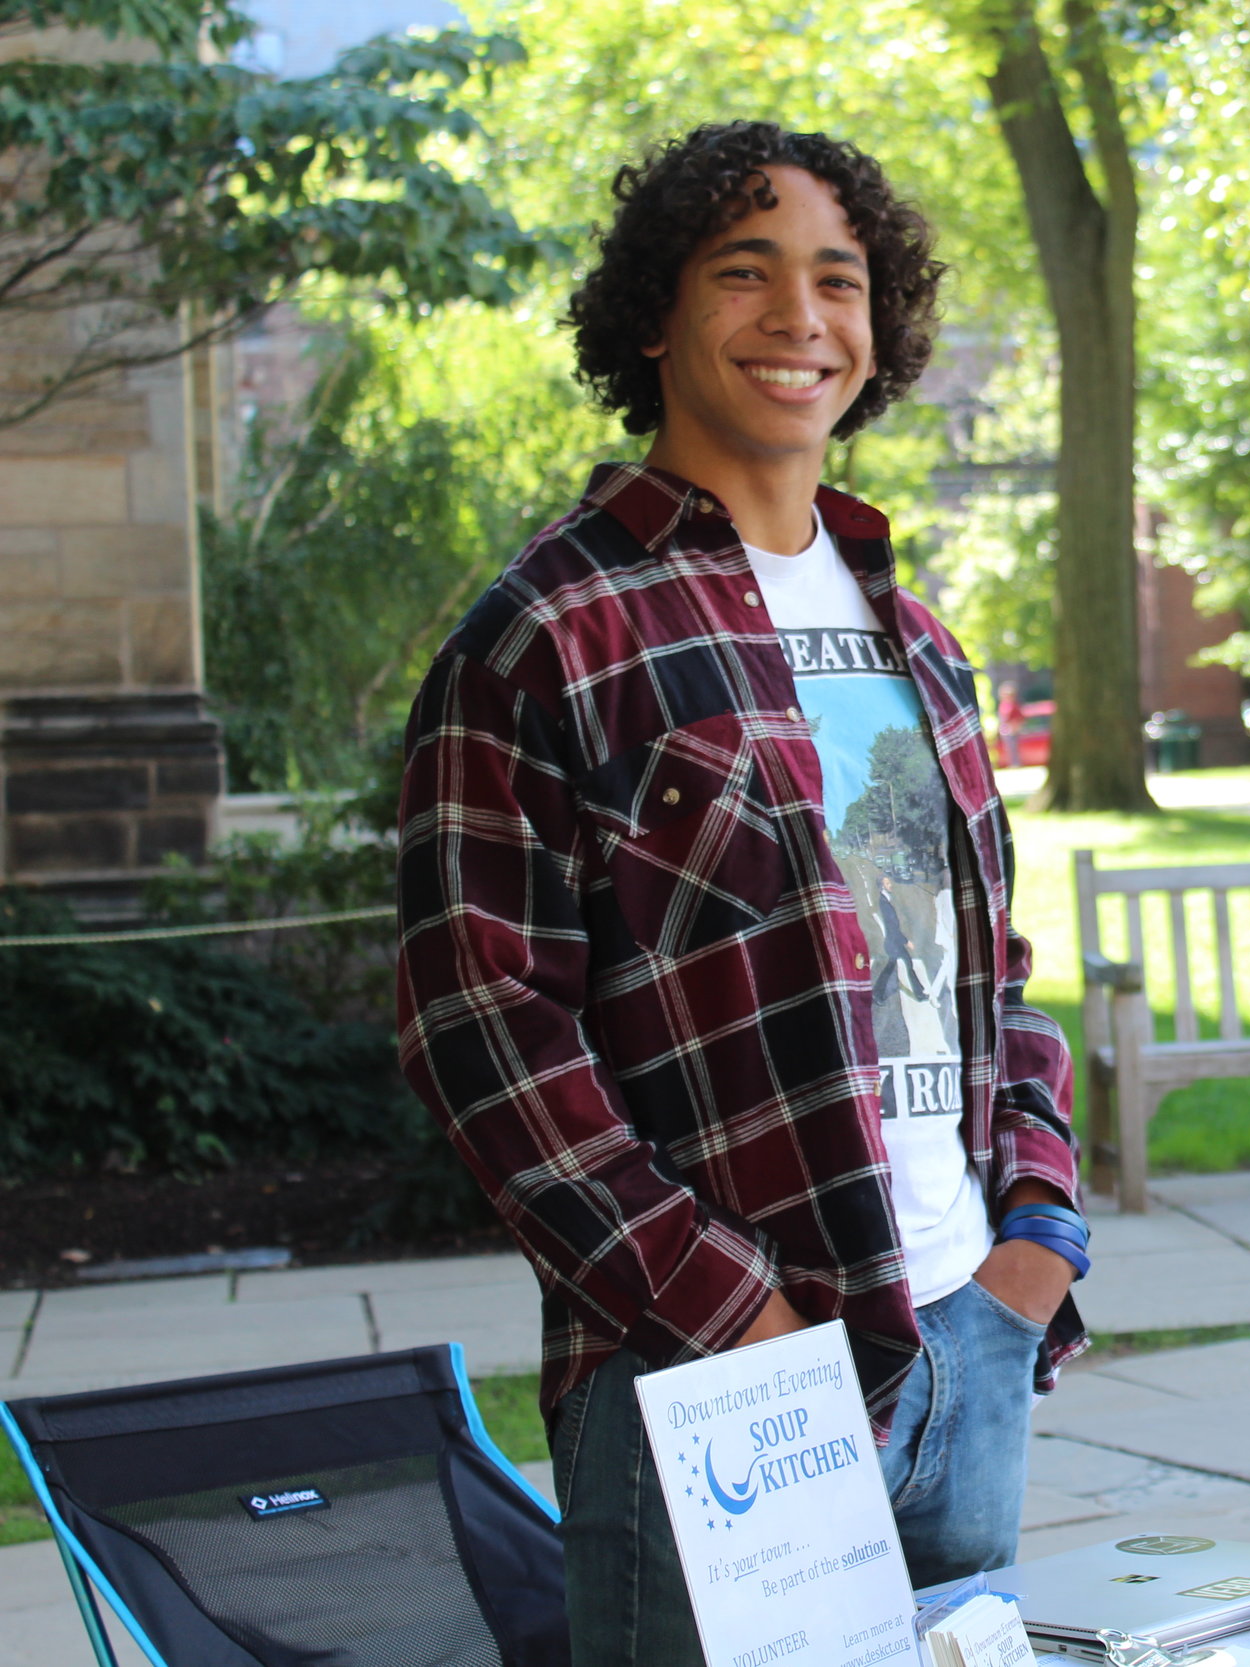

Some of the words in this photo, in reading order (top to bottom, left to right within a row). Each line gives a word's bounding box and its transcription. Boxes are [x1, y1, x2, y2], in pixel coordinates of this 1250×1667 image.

[779, 633, 907, 671] EATL
[907, 1067, 961, 1112] RO
[667, 1382, 771, 1429] Downtown
[773, 1358, 844, 1398] Evening
[750, 1407, 809, 1452] SOUP
[759, 1434, 859, 1493] KITCHEN
[269, 1489, 319, 1506] Helinox
[707, 1558, 731, 1584] It's
[734, 1552, 760, 1581] your
[761, 1540, 792, 1565] town
[762, 1579, 778, 1598] Be
[780, 1571, 807, 1597] part
[808, 1561, 822, 1585] of
[822, 1558, 840, 1577] the
[841, 1538, 892, 1571] solution.
[733, 1630, 810, 1667] VOLUNTEER
[843, 1629, 869, 1648] Learn
[870, 1619, 894, 1638] more
[895, 1614, 904, 1627] at
[997, 1635, 1014, 1657] SOUP
